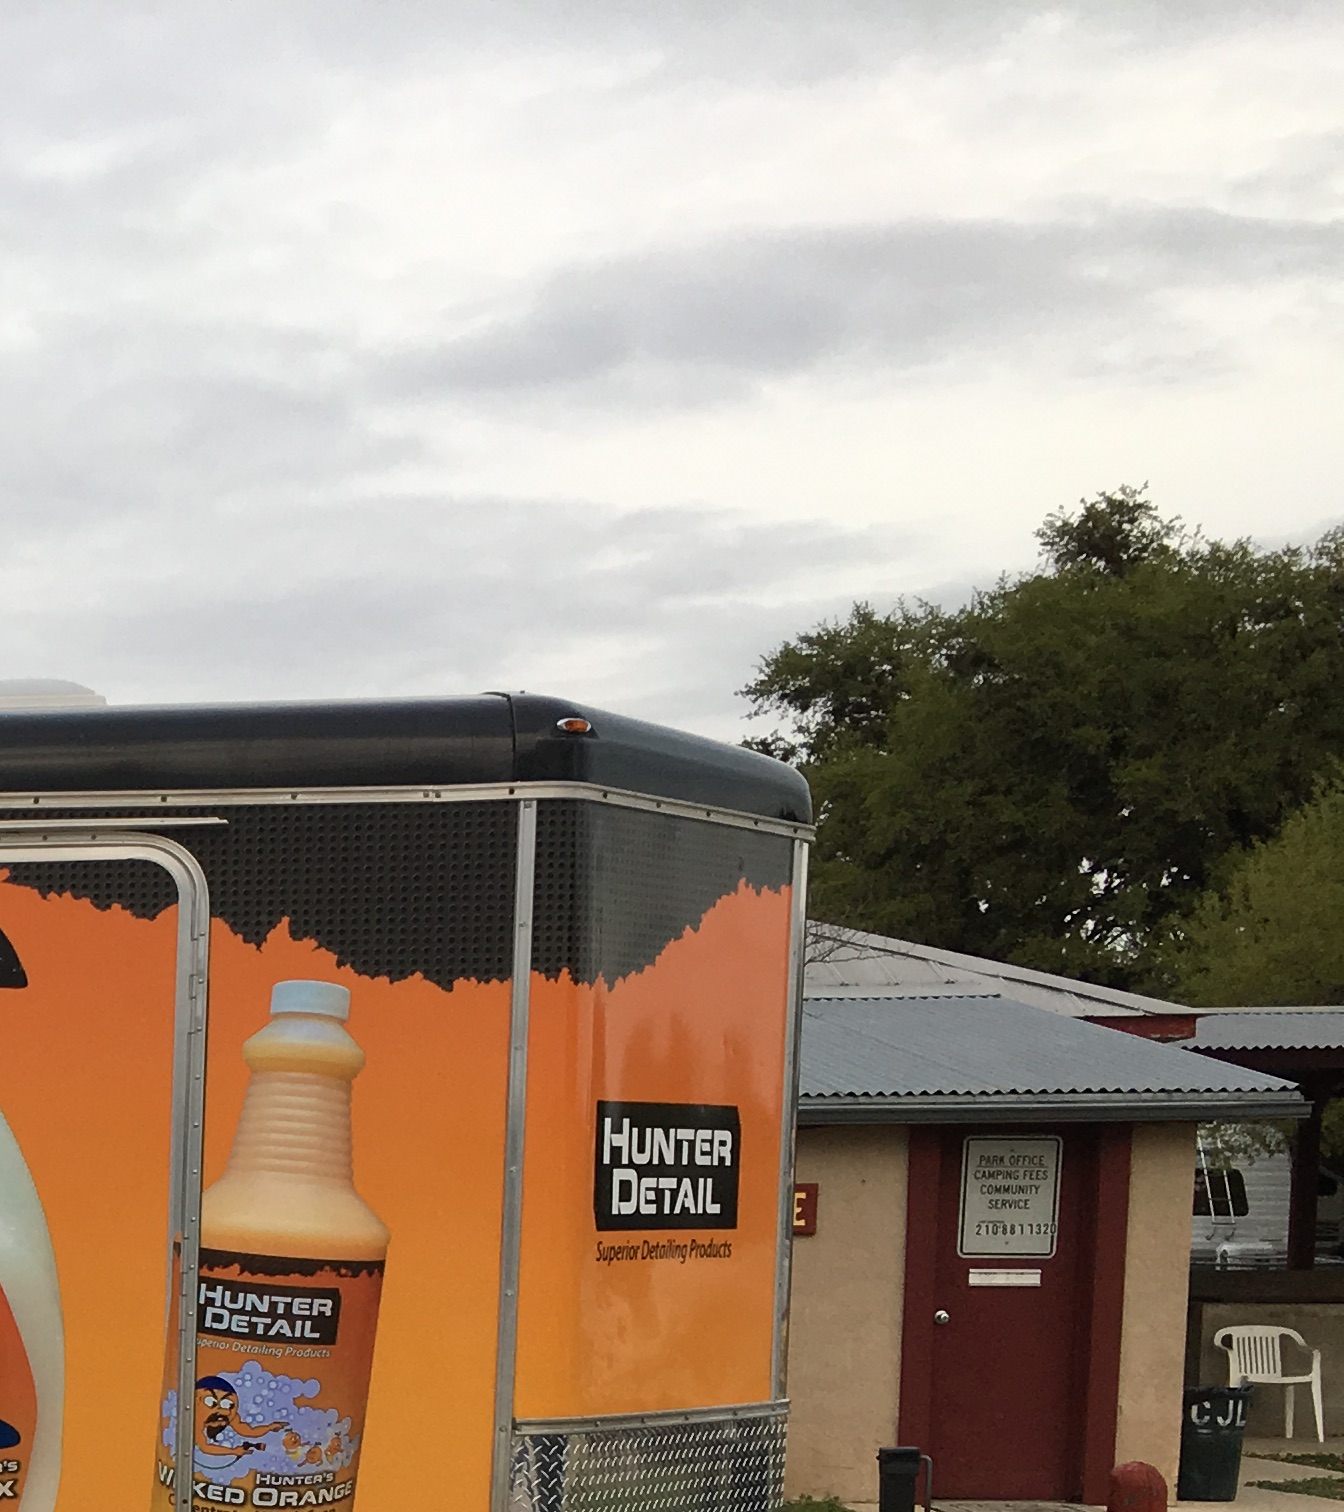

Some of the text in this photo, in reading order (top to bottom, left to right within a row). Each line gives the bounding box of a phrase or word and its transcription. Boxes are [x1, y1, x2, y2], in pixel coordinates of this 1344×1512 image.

[602, 1117, 733, 1166] HUNTER
[978, 1154, 1045, 1166] PARK OFFICE
[973, 1169, 1049, 1180] CAMPING FEES
[611, 1168, 721, 1215] DETAIL
[979, 1184, 1041, 1195] COMMUNITY
[987, 1198, 1031, 1210] SERVICE
[596, 1237, 733, 1267] Superior Detailing Products
[198, 1283, 333, 1317] HUNTER
[204, 1306, 321, 1339] DETAIL
[196, 1337, 331, 1359] uperior Detailing Products
[158, 1460, 353, 1508] WKED ORANGE
[255, 1472, 334, 1486] HUNTER'S
